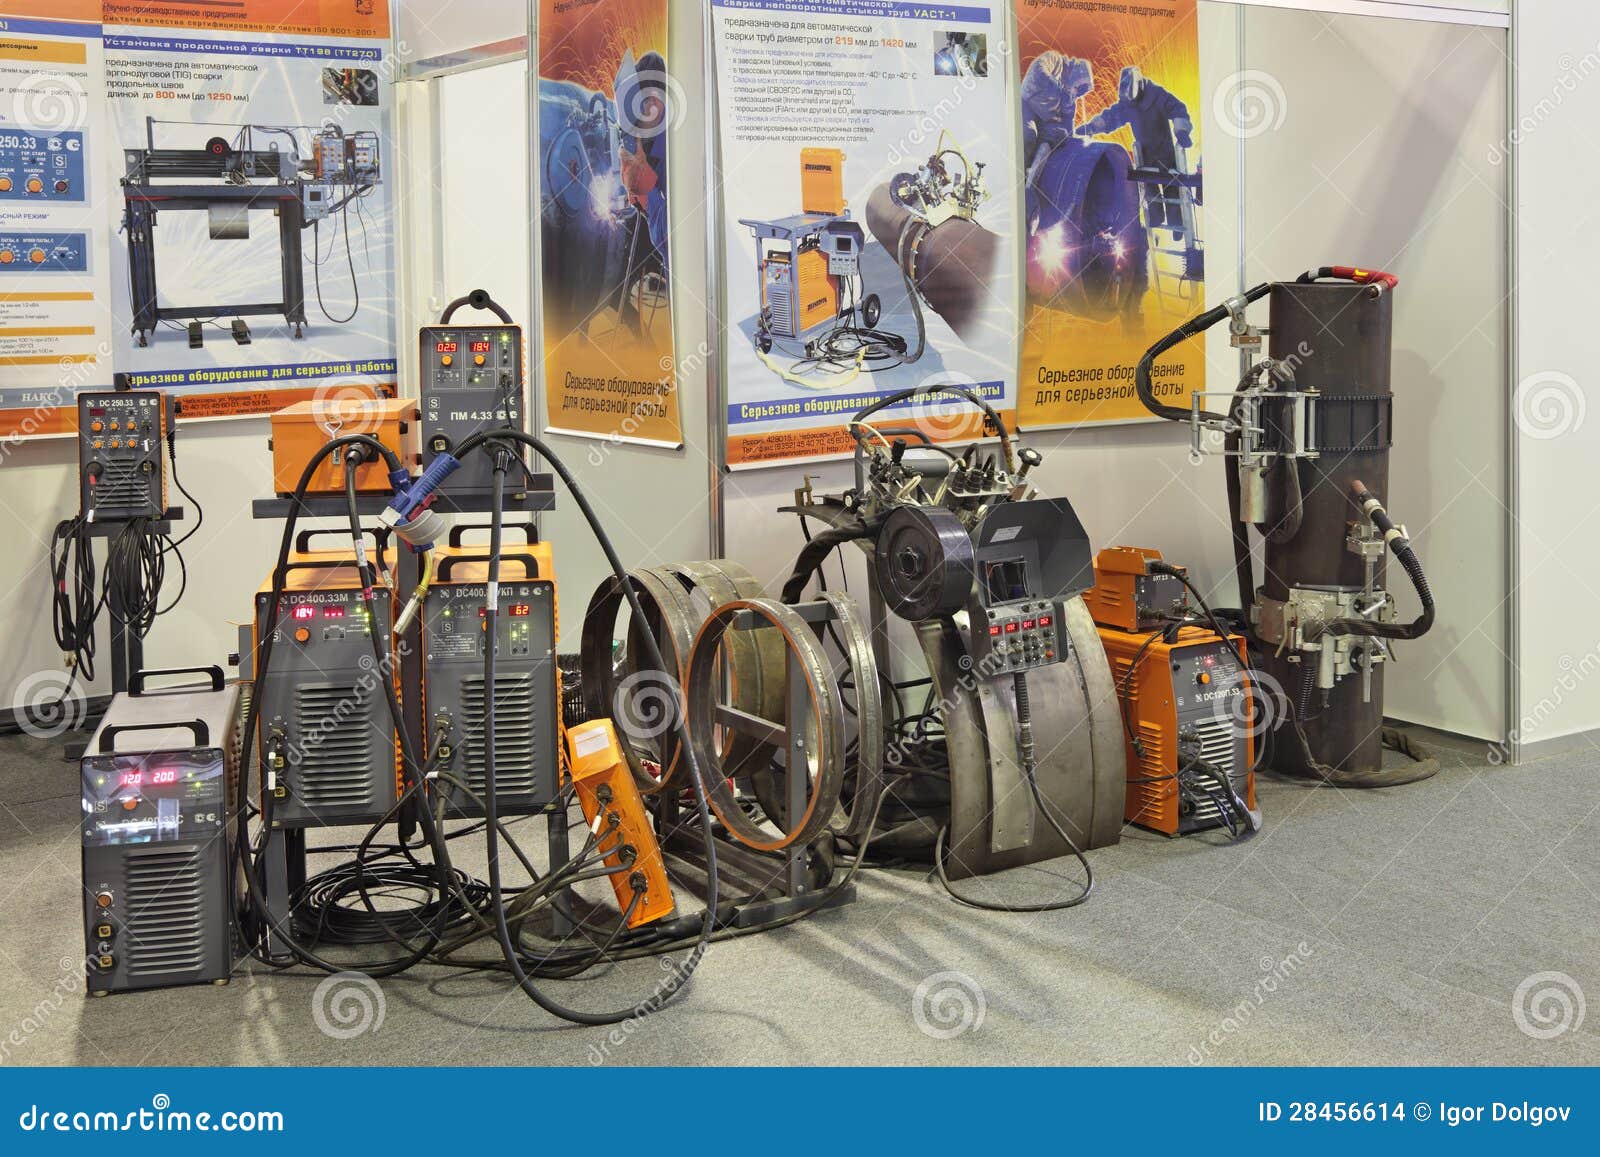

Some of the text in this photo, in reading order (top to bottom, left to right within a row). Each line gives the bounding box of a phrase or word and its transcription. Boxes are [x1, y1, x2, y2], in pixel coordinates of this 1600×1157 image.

[846, 8, 884, 16] стыков
[888, 9, 910, 17] труб
[914, 9, 957, 19] УАСТ-1
[1129, 6, 1176, 18] предприятие
[724, 17, 873, 34] предназначена для автоматической
[725, 32, 755, 42] сварки
[756, 33, 776, 44] труб
[777, 36, 823, 46] диаметром
[825, 38, 834, 46] от
[835, 36, 854, 46] 219
[881, 38, 904, 48] 1420
[905, 41, 918, 49] мм
[105, 38, 171, 49] Установка
[175, 42, 248, 53] продольной
[251, 45, 292, 56] сварки
[105, 59, 259, 72] предназначена для автоматической
[106, 69, 171, 79] аргонодуговой
[193, 73, 223, 81] сварки
[106, 80, 160, 88] продольных
[107, 90, 139, 99] длиной
[155, 91, 175, 99] 800
[207, 92, 232, 101] 1250
[129, 361, 395, 387] ерьезное оборудование для серьезной работы
[1038, 363, 1185, 386] Серьезное оборование
[565, 371, 670, 397] Серьезное оборудование
[21, 391, 56, 402] НАКС
[1035, 383, 1184, 406] для серьезной боты
[563, 394, 668, 418] для серьезной работы
[741, 400, 800, 418] Серьезное
[804, 395, 881, 413] оборудование
[450, 411, 493, 420] ПМ 4.33
[290, 593, 349, 604] DC400.33М
[515, 605, 529, 615] 62
[153, 772, 174, 783] 200
